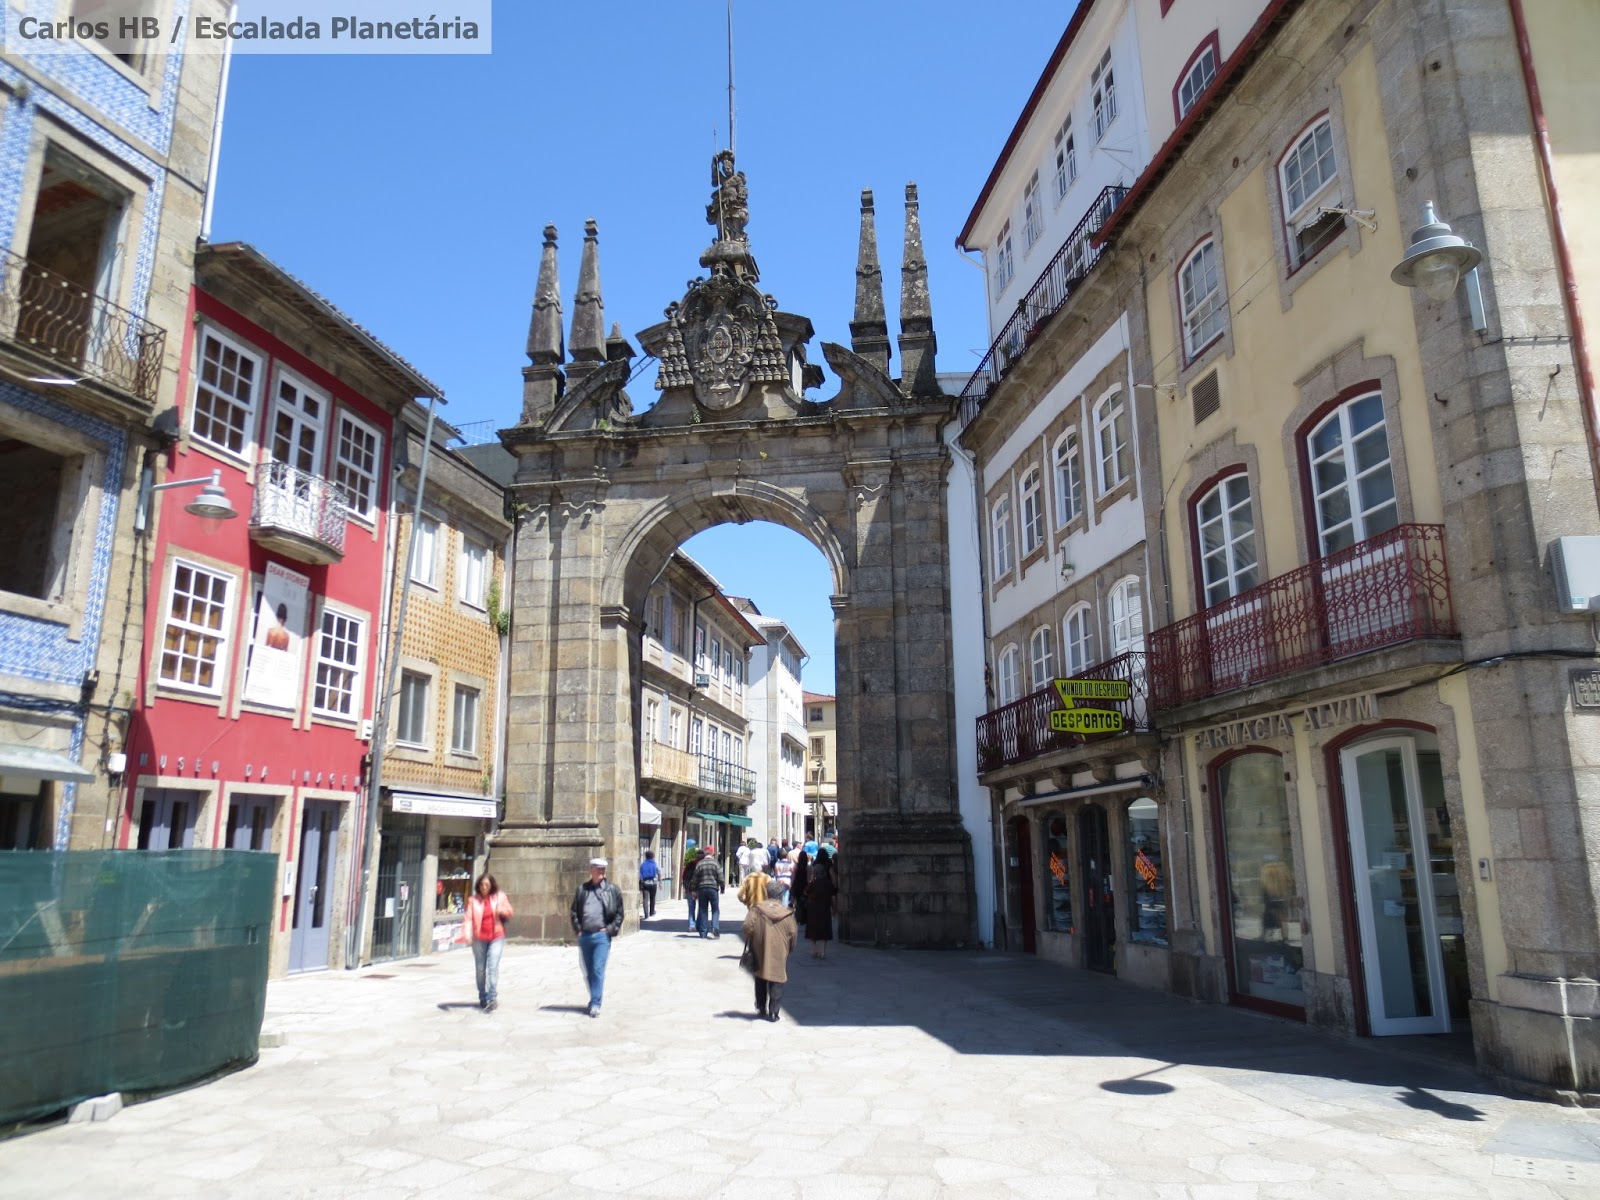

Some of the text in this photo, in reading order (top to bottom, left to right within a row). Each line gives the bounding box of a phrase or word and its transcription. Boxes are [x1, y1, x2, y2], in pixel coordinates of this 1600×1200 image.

[1061, 682, 1127, 697] MUNDO DO DESPORTO
[1053, 713, 1120, 729] DESPORTOS
[1303, 694, 1373, 731] ALVIM
[140, 752, 361, 787] MUSEU DA IMAGEM
